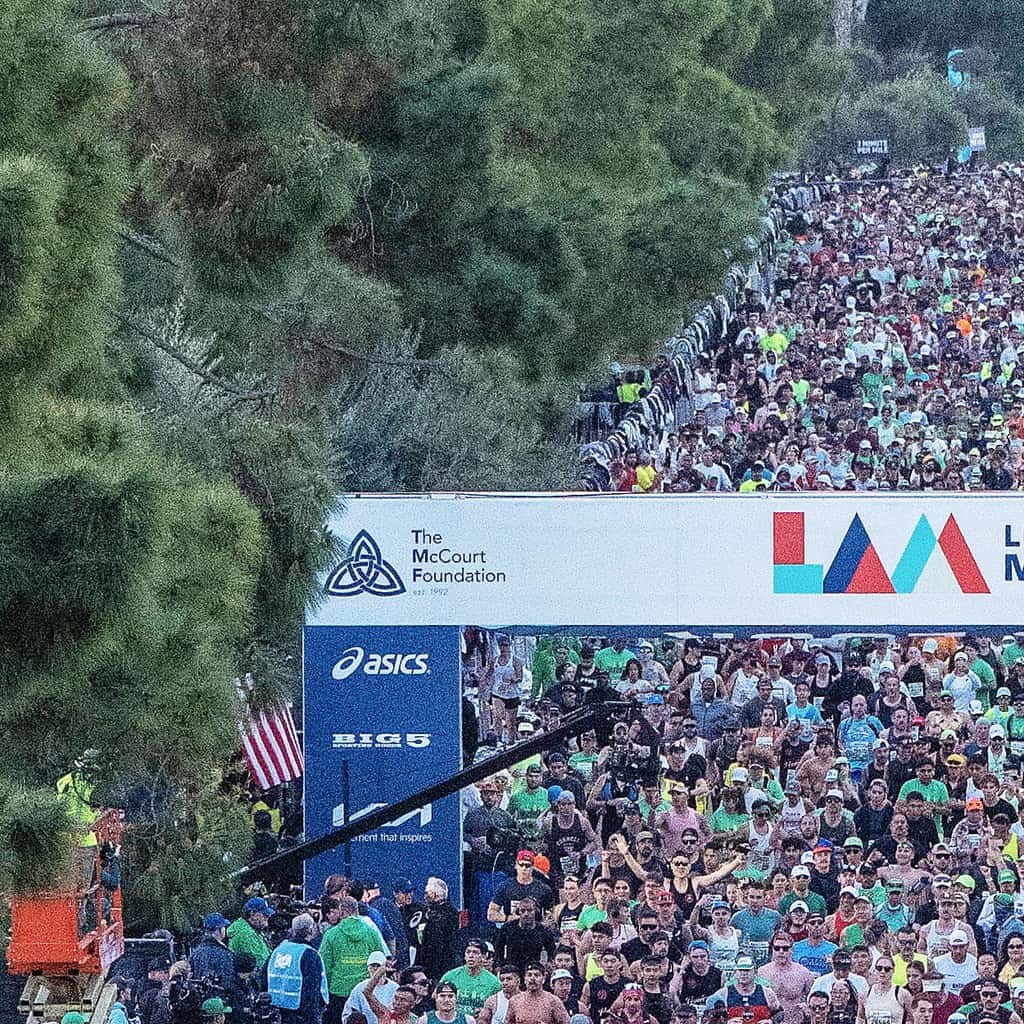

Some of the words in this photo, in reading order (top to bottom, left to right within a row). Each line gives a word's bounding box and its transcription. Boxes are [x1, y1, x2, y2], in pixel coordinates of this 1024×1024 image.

[411, 528, 443, 544] The
[412, 549, 487, 564] McCourt
[412, 567, 506, 583] Foundation
[332, 734, 402, 744] BIG
[406, 734, 432, 748] 5
[380, 832, 397, 842] that
[400, 832, 432, 843] inspires
